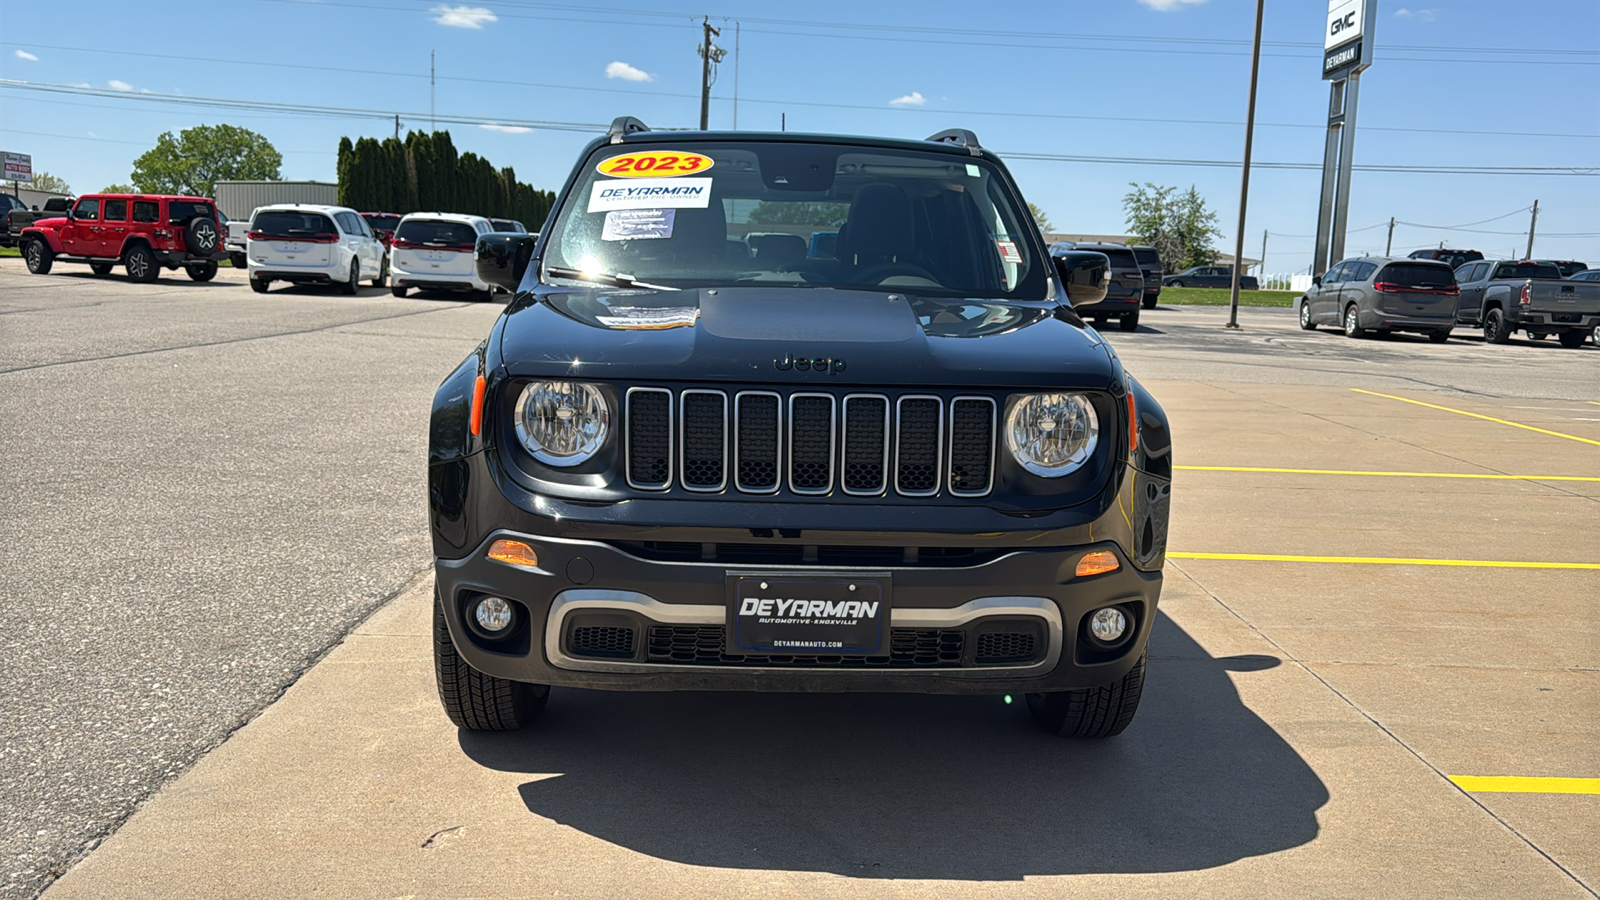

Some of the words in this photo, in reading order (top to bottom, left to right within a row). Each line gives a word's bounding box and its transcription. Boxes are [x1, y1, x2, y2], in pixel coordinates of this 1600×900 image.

[1331, 10, 1355, 36] GMC
[1326, 47, 1355, 70] DEYARMAN
[609, 156, 703, 173] 2023
[600, 186, 704, 198] DEYARMAN
[773, 352, 847, 376] Jeep
[739, 597, 879, 618] DEYARMAN
[773, 640, 843, 648] DEYARMANAUTO.COM
